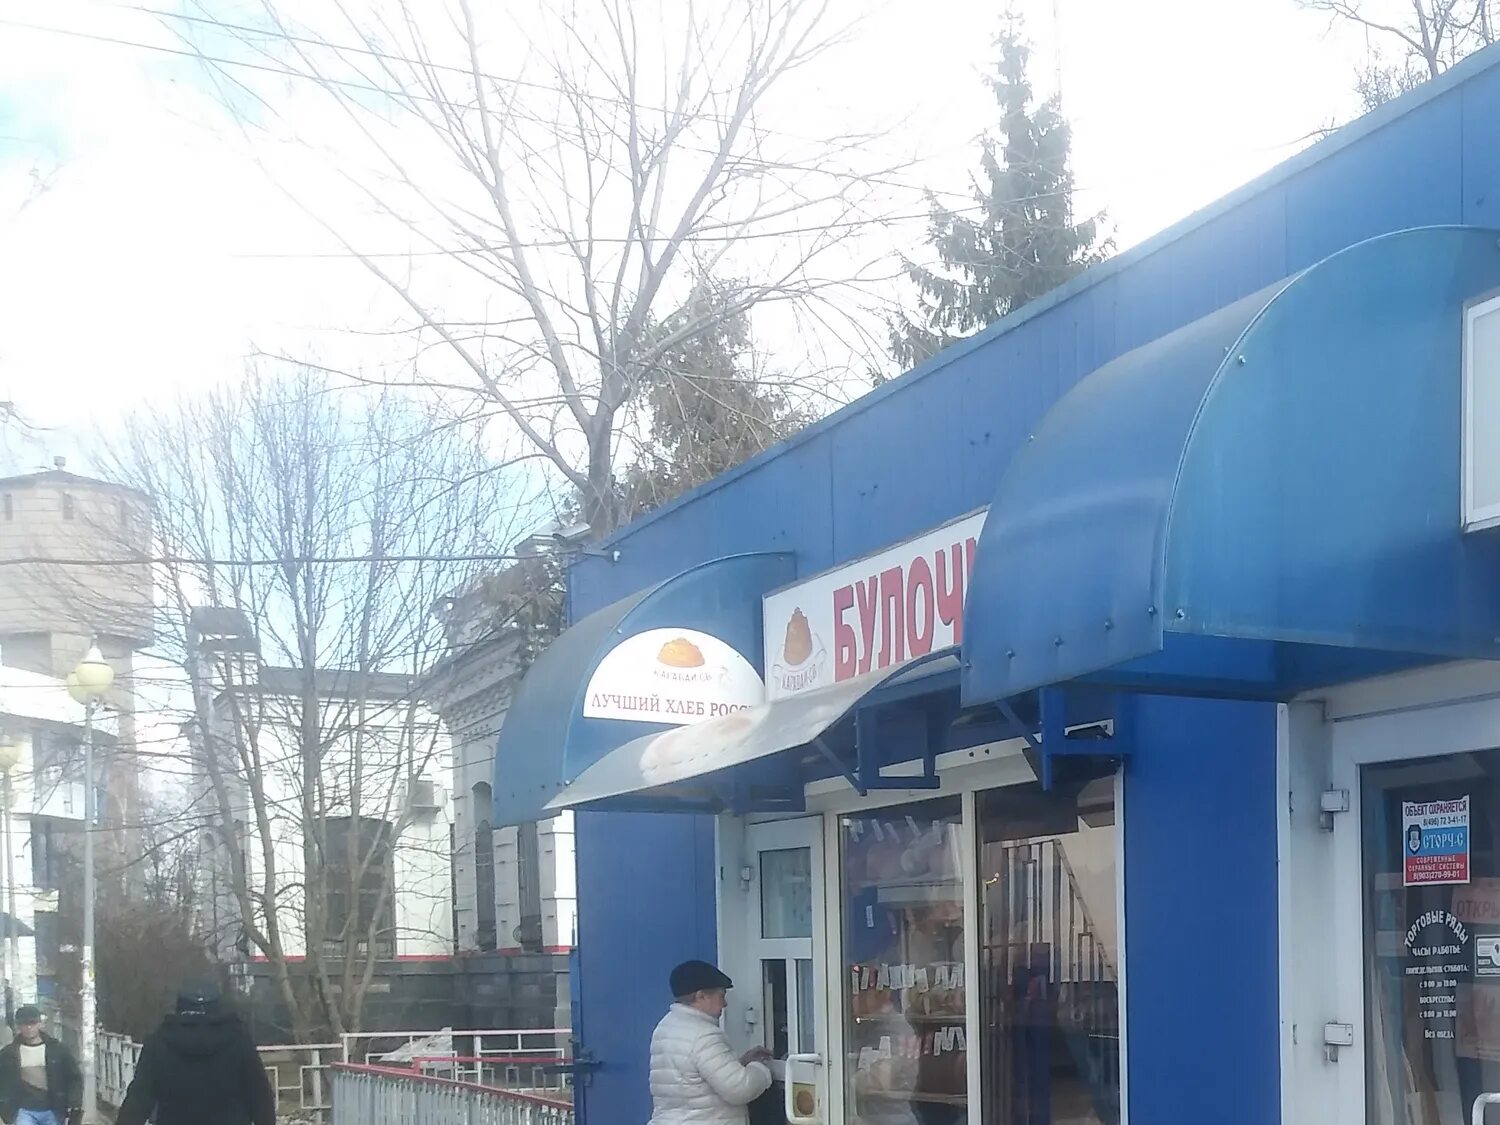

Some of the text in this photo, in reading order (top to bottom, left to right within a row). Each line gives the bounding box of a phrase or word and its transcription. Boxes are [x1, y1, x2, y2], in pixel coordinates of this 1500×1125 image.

[832, 536, 977, 683] БУЛОЧ
[591, 692, 753, 717] ЛУЧШИЙ ХЛЕБ РОС
[1405, 800, 1467, 817] ОБЪЕКТ ОХРАНЯЕТСЯ
[1423, 832, 1464, 849] СТОРЧ-С
[1404, 910, 1444, 948] ТОРГОВЫЕ
[1445, 912, 1469, 945] РЯДЫ
